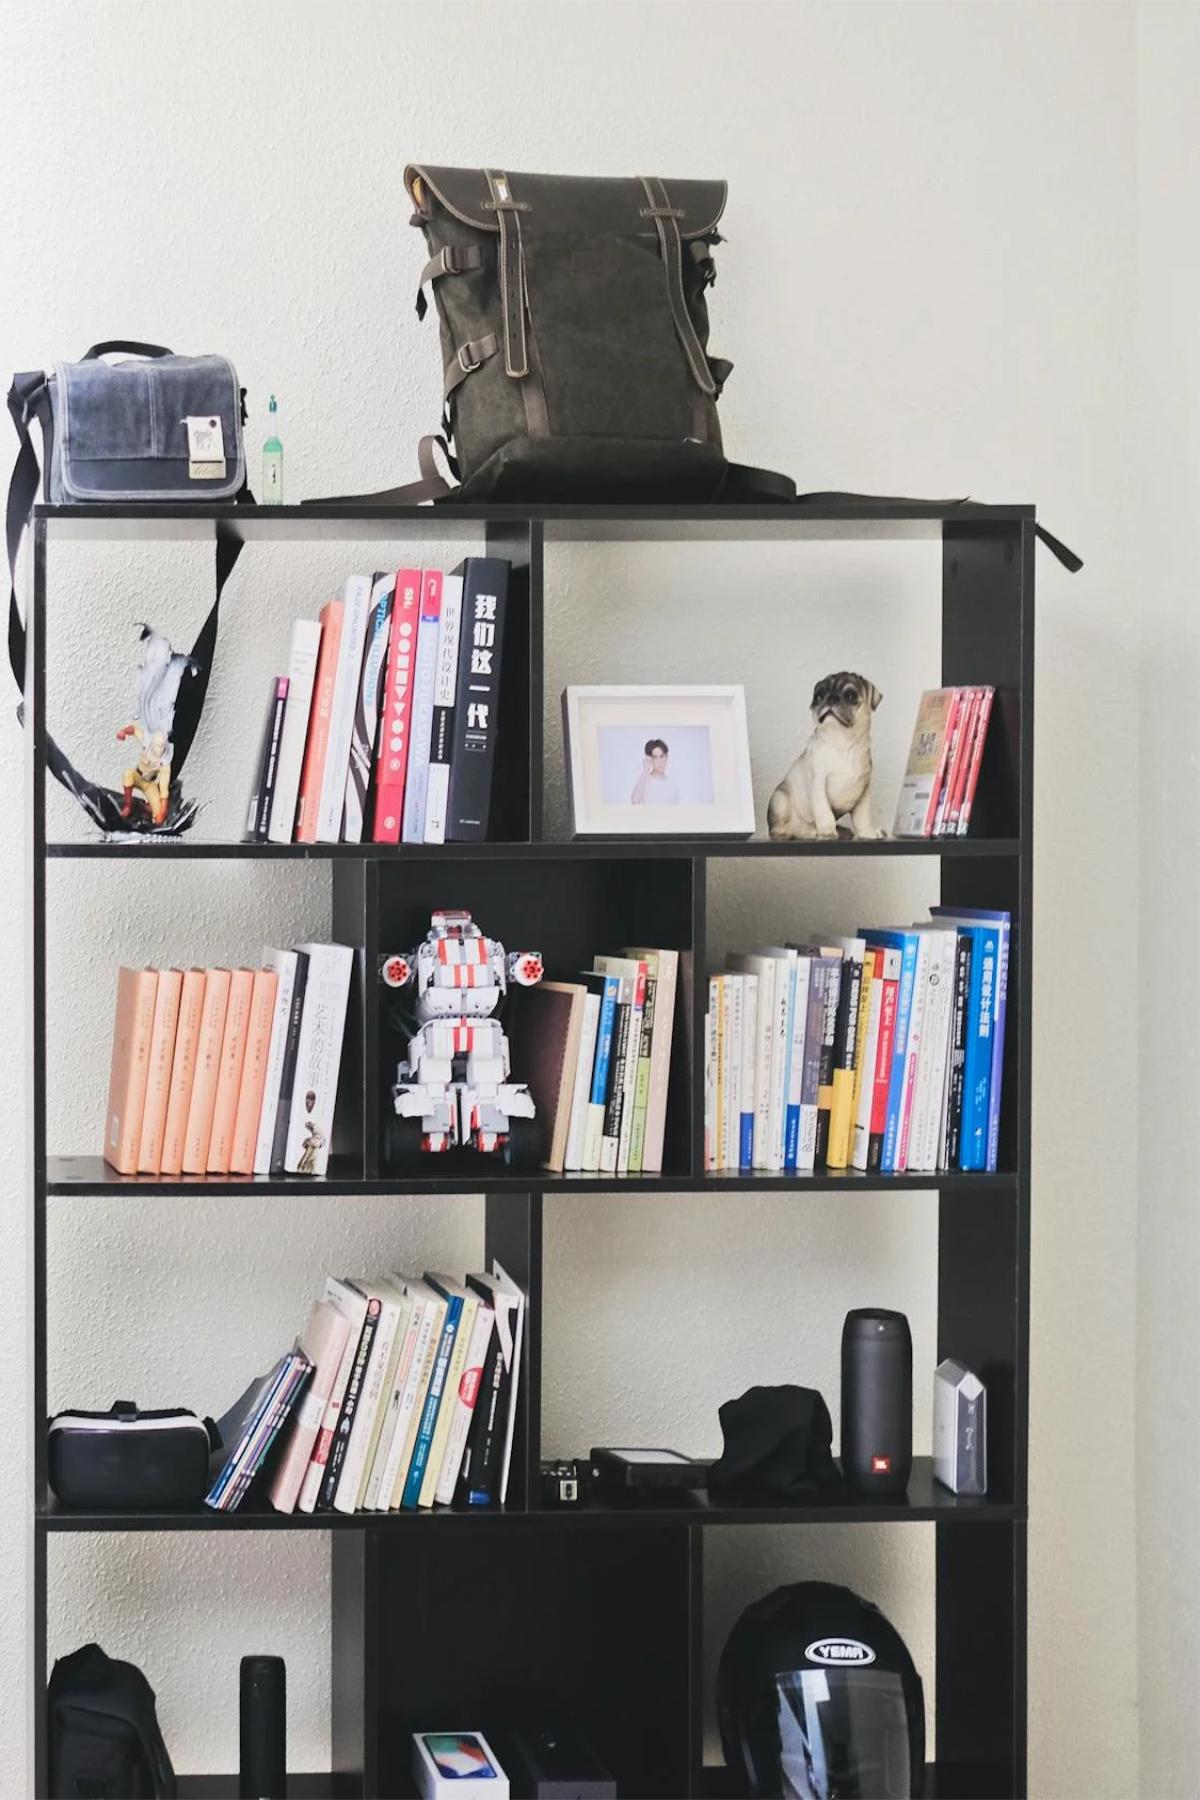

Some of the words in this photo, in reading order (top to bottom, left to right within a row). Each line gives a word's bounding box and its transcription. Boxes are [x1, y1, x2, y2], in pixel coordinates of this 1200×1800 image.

[372, 592, 388, 642] OPTICAL
[420, 624, 438, 679] NAOTO
[365, 643, 381, 706] ILLUSIONS
[440, 607, 455, 701] 世界现代设计史
[467, 594, 497, 729] 我们这一代
[414, 685, 433, 767] FUKASAWA
[309, 1003, 327, 1086] 艺术的故事
[819, 1645, 864, 1659] YEMA
